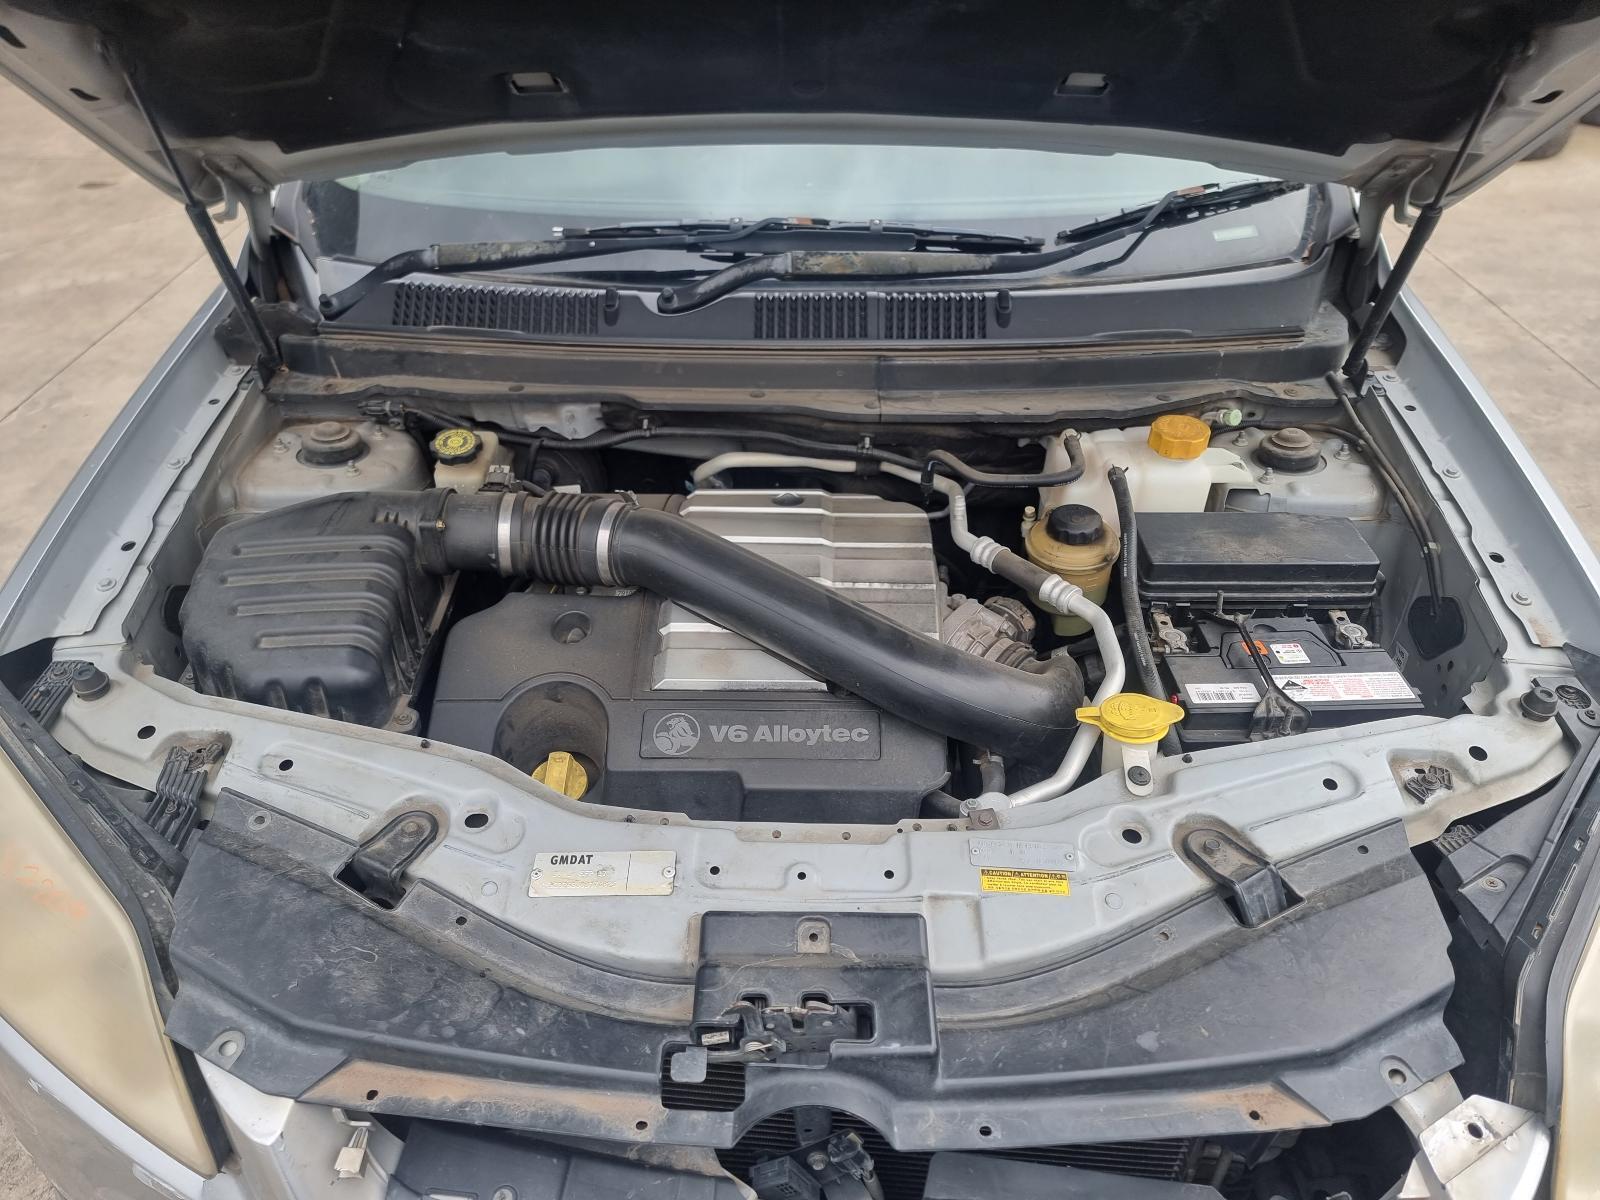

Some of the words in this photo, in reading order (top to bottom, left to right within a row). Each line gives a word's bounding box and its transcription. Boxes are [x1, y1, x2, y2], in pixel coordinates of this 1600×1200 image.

[709, 725, 748, 743] V6
[752, 724, 870, 746] Alloytec
[550, 854, 593, 866] GMDAT
